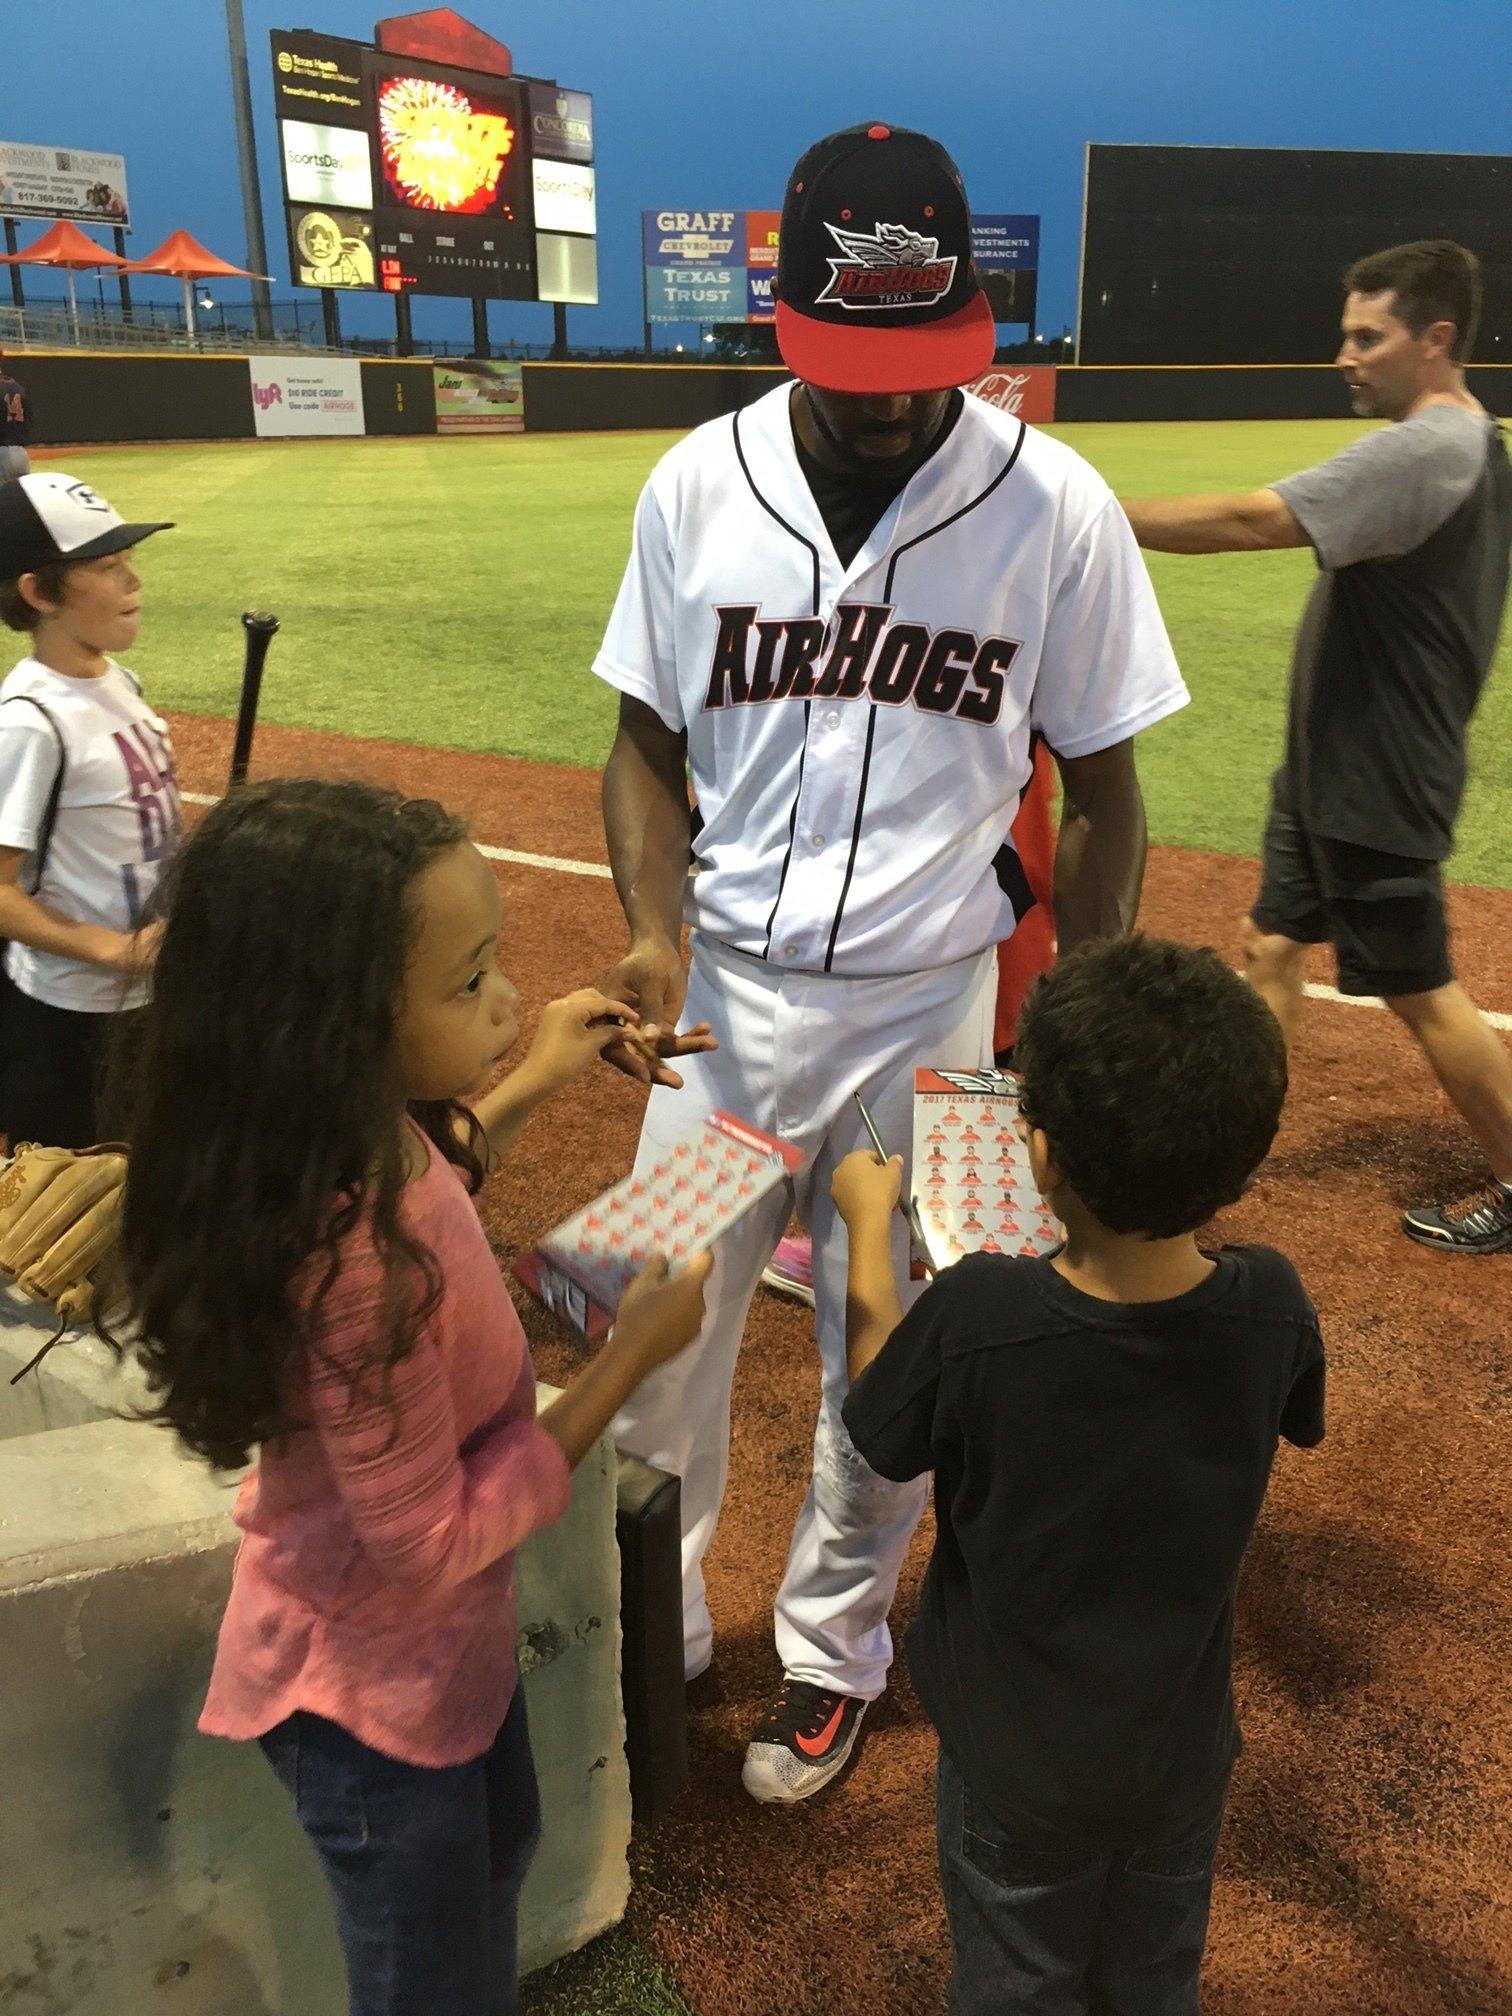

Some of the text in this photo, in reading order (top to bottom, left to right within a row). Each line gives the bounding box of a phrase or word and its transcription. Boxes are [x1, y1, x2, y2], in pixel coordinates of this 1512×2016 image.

[292, 54, 338, 73] Texas Health
[657, 212, 734, 232] GRAFF
[971, 227, 1007, 235] ANKING
[663, 241, 730, 251] CHEVROLET
[973, 239, 1030, 247] VESTMENTS
[663, 269, 731, 284] TEXAS
[664, 288, 731, 302] TRUST
[878, 294, 912, 304] TEXAS
[702, 601, 1024, 727] AIRHOGS
[923, 1095, 945, 1104] 2017
[947, 1096, 976, 1104] TEXAS
